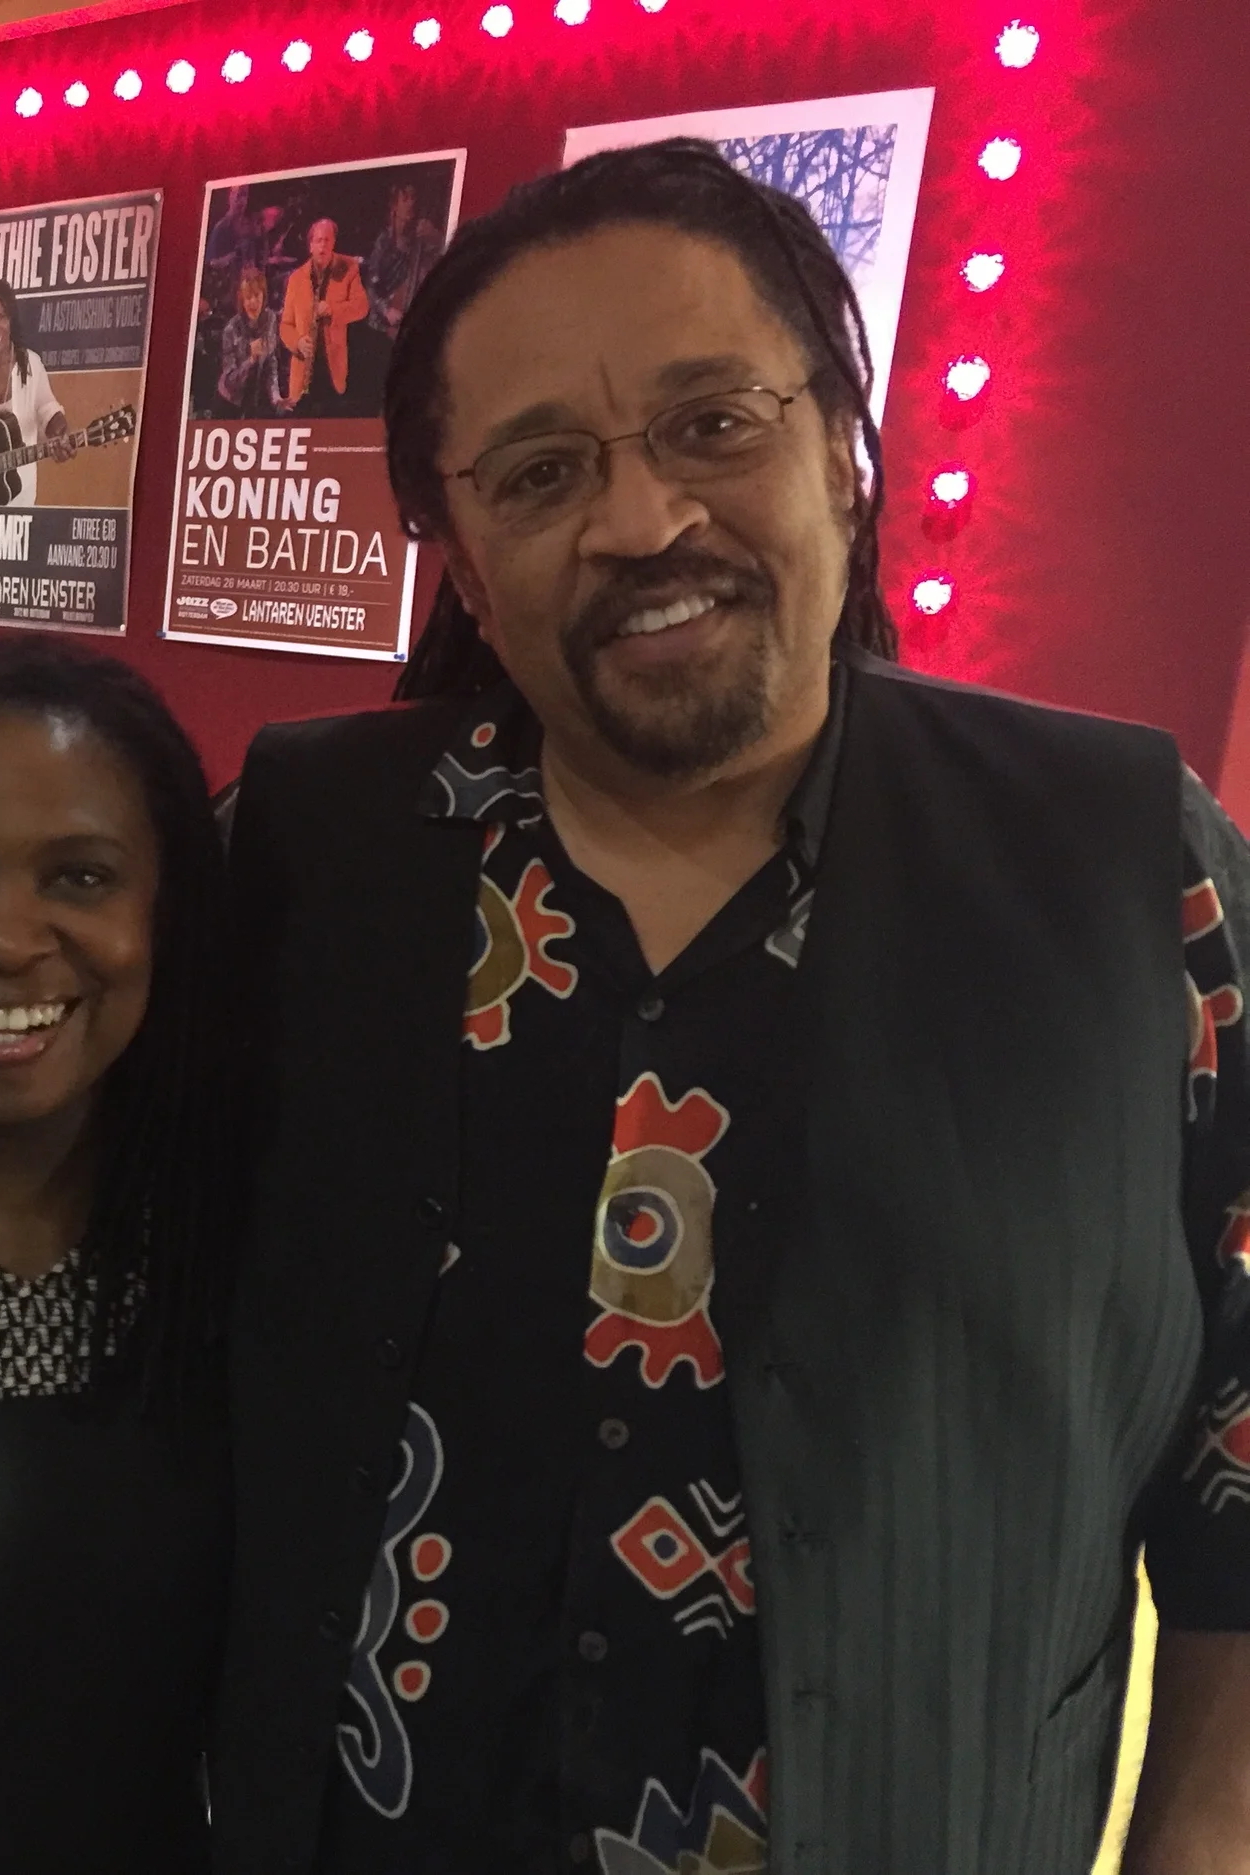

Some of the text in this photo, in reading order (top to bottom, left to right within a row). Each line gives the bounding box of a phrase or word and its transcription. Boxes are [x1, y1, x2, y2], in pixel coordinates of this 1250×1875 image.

[49, 204, 155, 286] FOSTER
[38, 294, 145, 333] AN ASTONISHING VOICE
[188, 427, 312, 471] JOSEE
[185, 476, 341, 523] KONING
[72, 517, 101, 541] ENTREE
[86, 545, 110, 569] 20.30
[182, 524, 388, 577] EN BATIDA
[180, 575, 222, 588] ZATERDAG
[236, 578, 267, 591] MAART
[274, 580, 300, 593] 20.30
[301, 582, 321, 594] UUR
